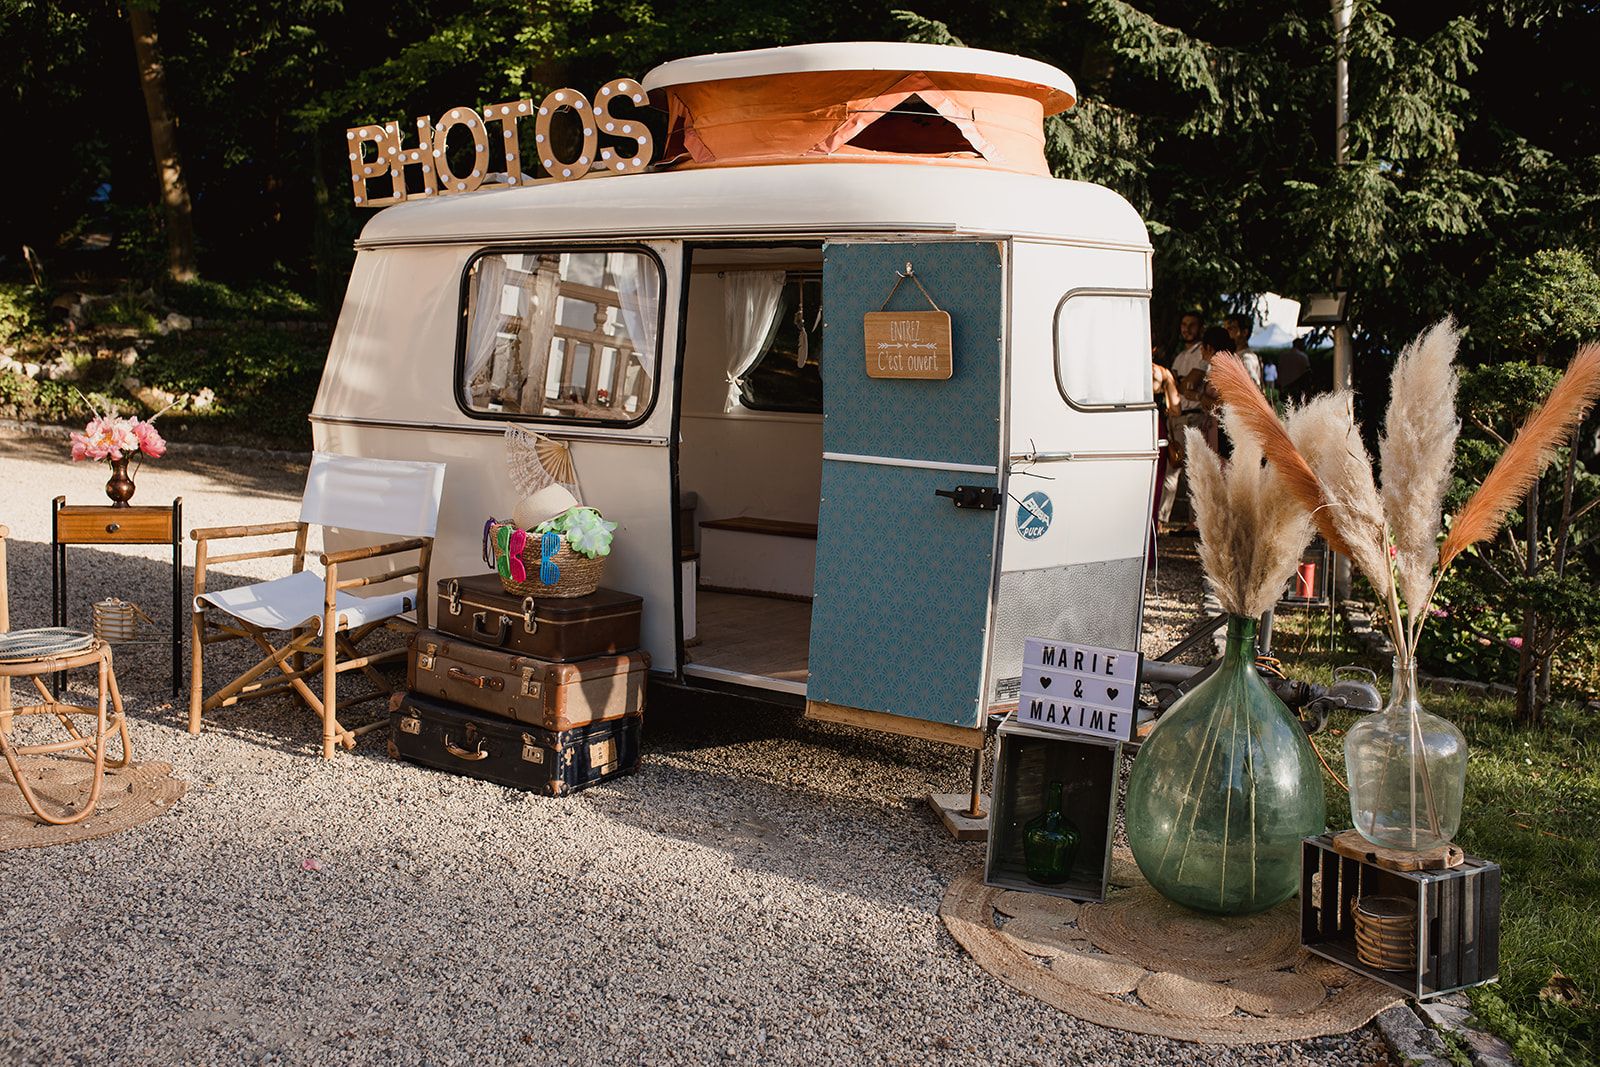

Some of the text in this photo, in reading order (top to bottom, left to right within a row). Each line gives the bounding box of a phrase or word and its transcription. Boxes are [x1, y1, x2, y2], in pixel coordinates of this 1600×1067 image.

[346, 77, 653, 206] PHOTOS
[877, 351, 939, 371] C'est ouvert
[1023, 526, 1045, 537] PUCK
[1042, 646, 1116, 676] MARIE
[1073, 679, 1084, 699] &
[1030, 700, 1118, 733] MAXIME
